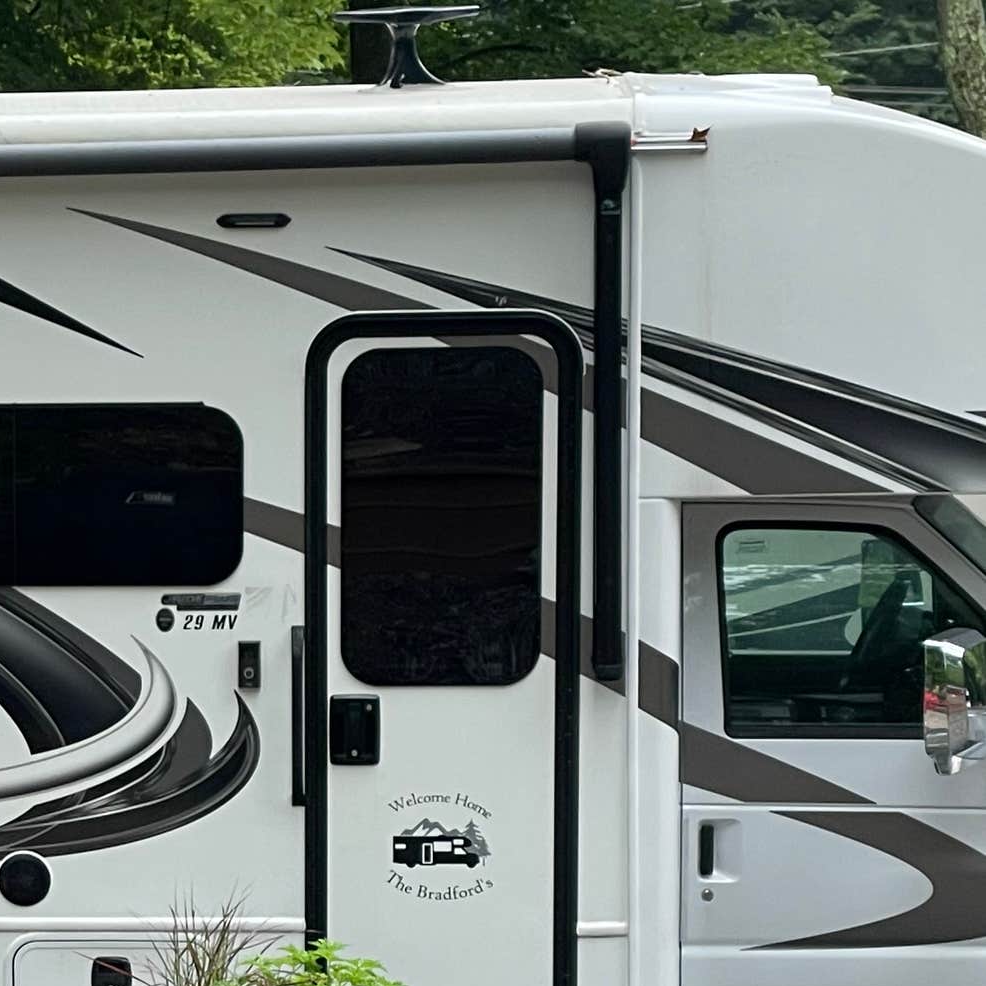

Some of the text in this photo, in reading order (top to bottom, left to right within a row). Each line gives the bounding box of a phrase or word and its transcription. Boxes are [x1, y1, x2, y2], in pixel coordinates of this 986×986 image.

[183, 614, 205, 631] 29
[211, 614, 238, 630] MV
[388, 792, 492, 819] Welcome Home
[387, 869, 494, 901] The Bradford's
